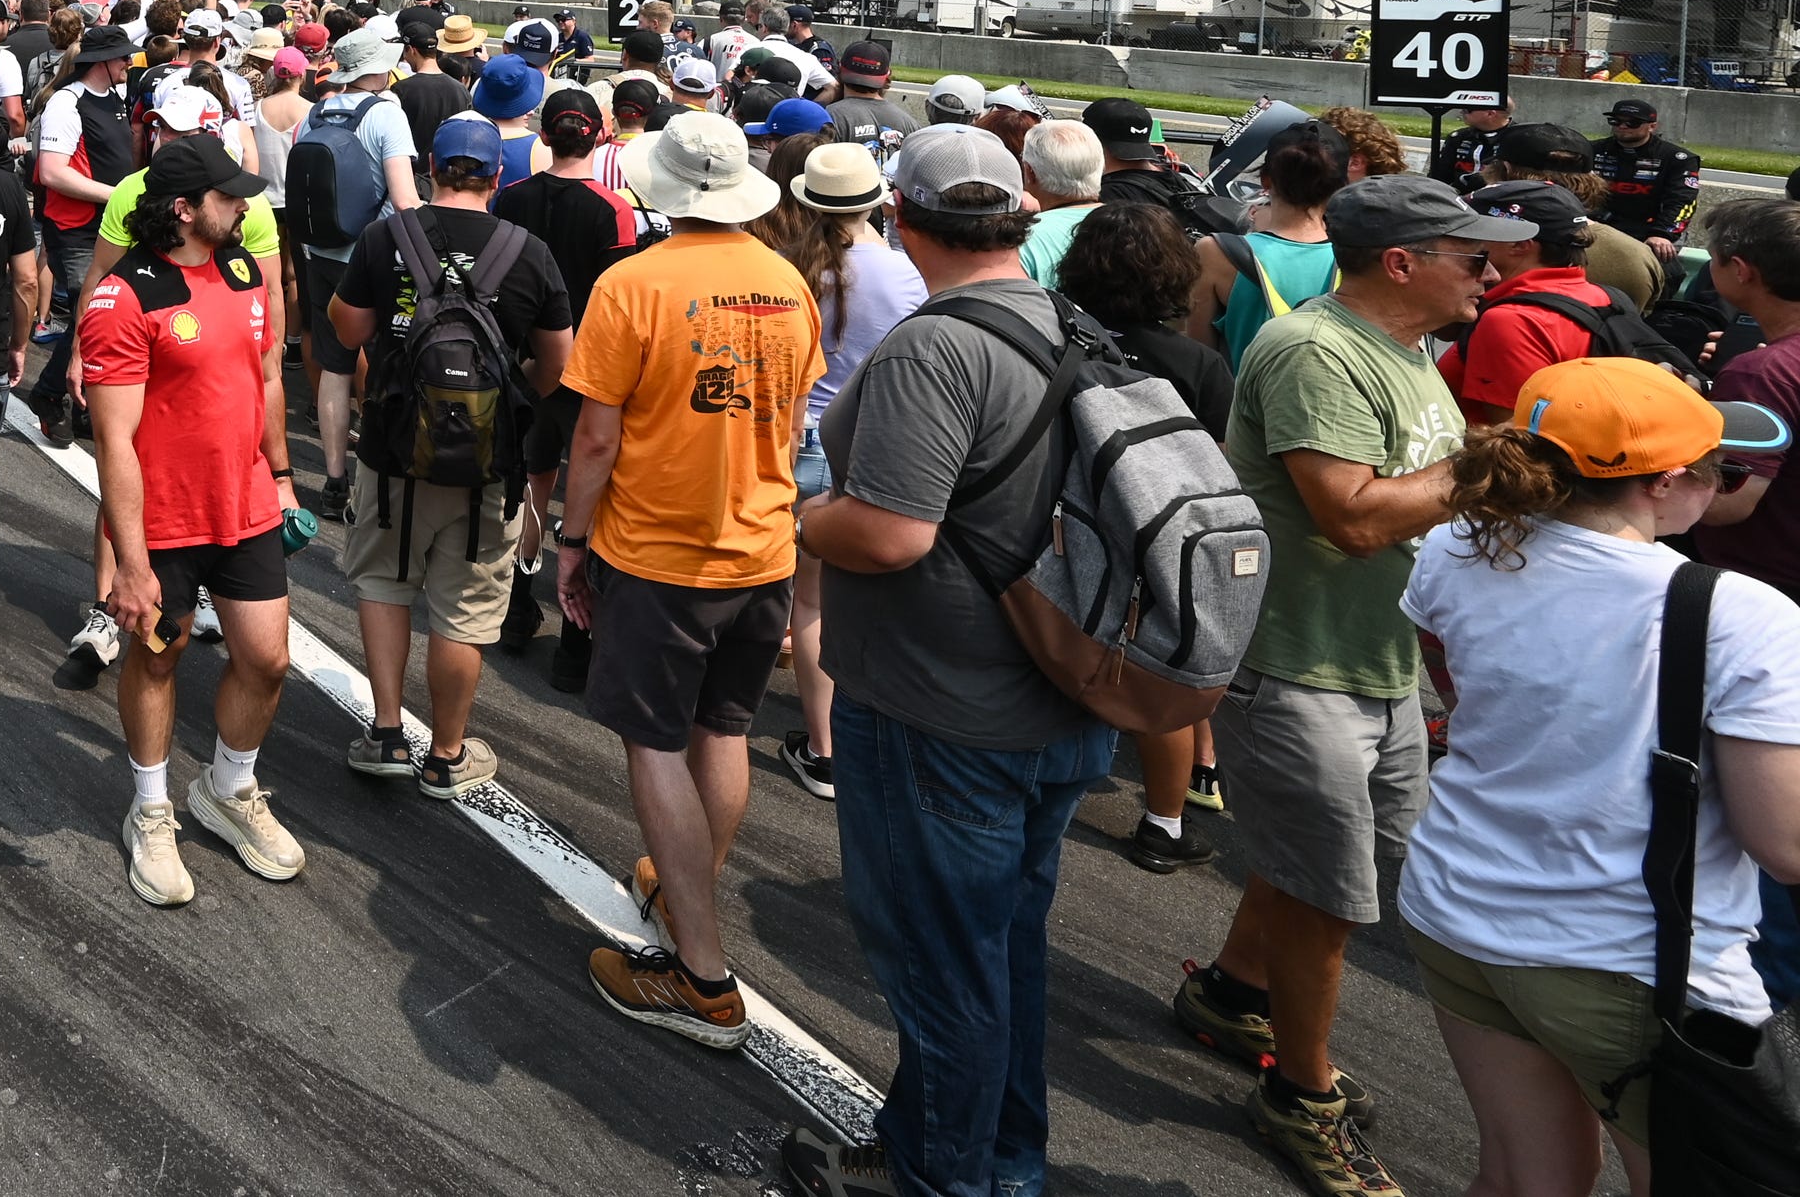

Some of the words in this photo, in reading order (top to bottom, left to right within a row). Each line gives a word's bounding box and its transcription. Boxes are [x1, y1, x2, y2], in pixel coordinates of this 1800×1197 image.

[1453, 13, 1492, 22] GTP
[1392, 31, 1485, 80] 40
[1221, 118, 1243, 144] JORDAN
[1238, 105, 1261, 127] TAYLOR
[1509, 203, 1521, 214] 3
[711, 295, 739, 308] TAIL
[750, 292, 801, 309] DRAGON
[445, 368, 468, 377] Canon
[697, 369, 735, 382] DRAGON
[697, 379, 735, 401] 129
